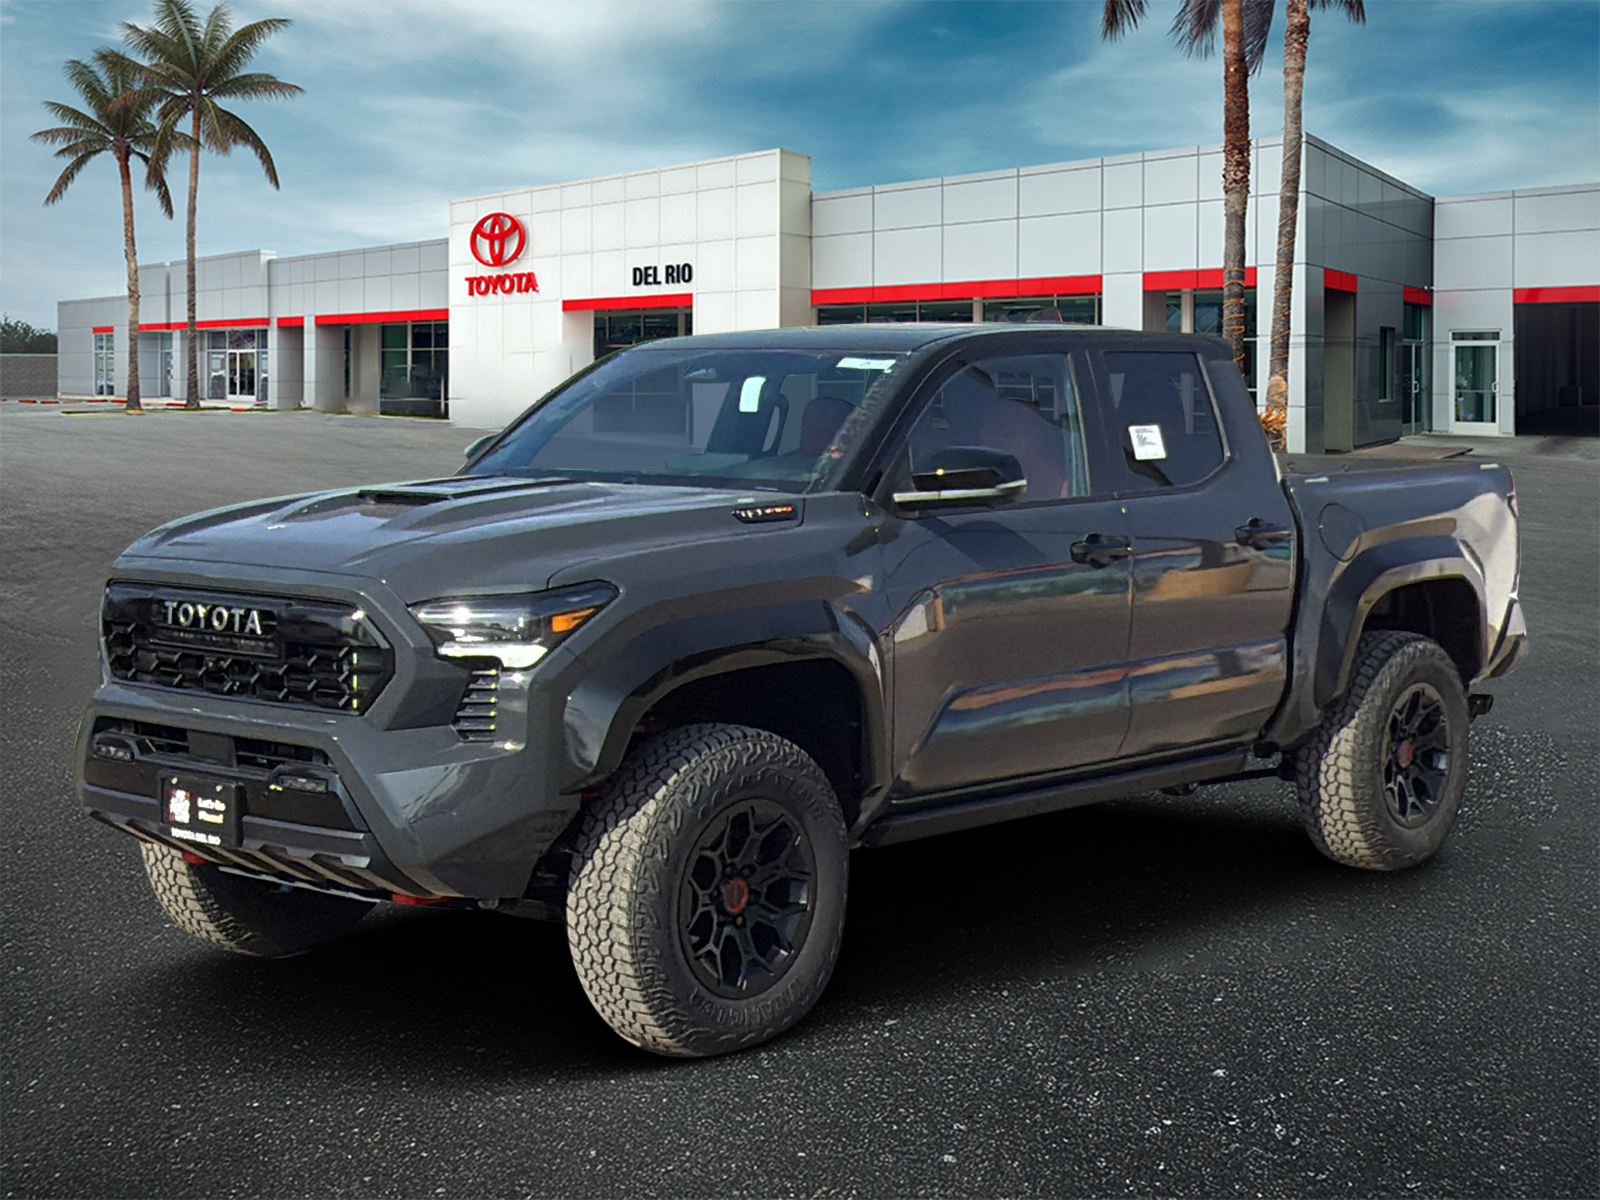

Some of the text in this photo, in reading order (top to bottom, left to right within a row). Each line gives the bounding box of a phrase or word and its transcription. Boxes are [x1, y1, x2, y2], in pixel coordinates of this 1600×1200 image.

[464, 271, 539, 296] TOYOTA
[632, 263, 693, 286] DEL RIO
[164, 600, 262, 635] TOYOTA
